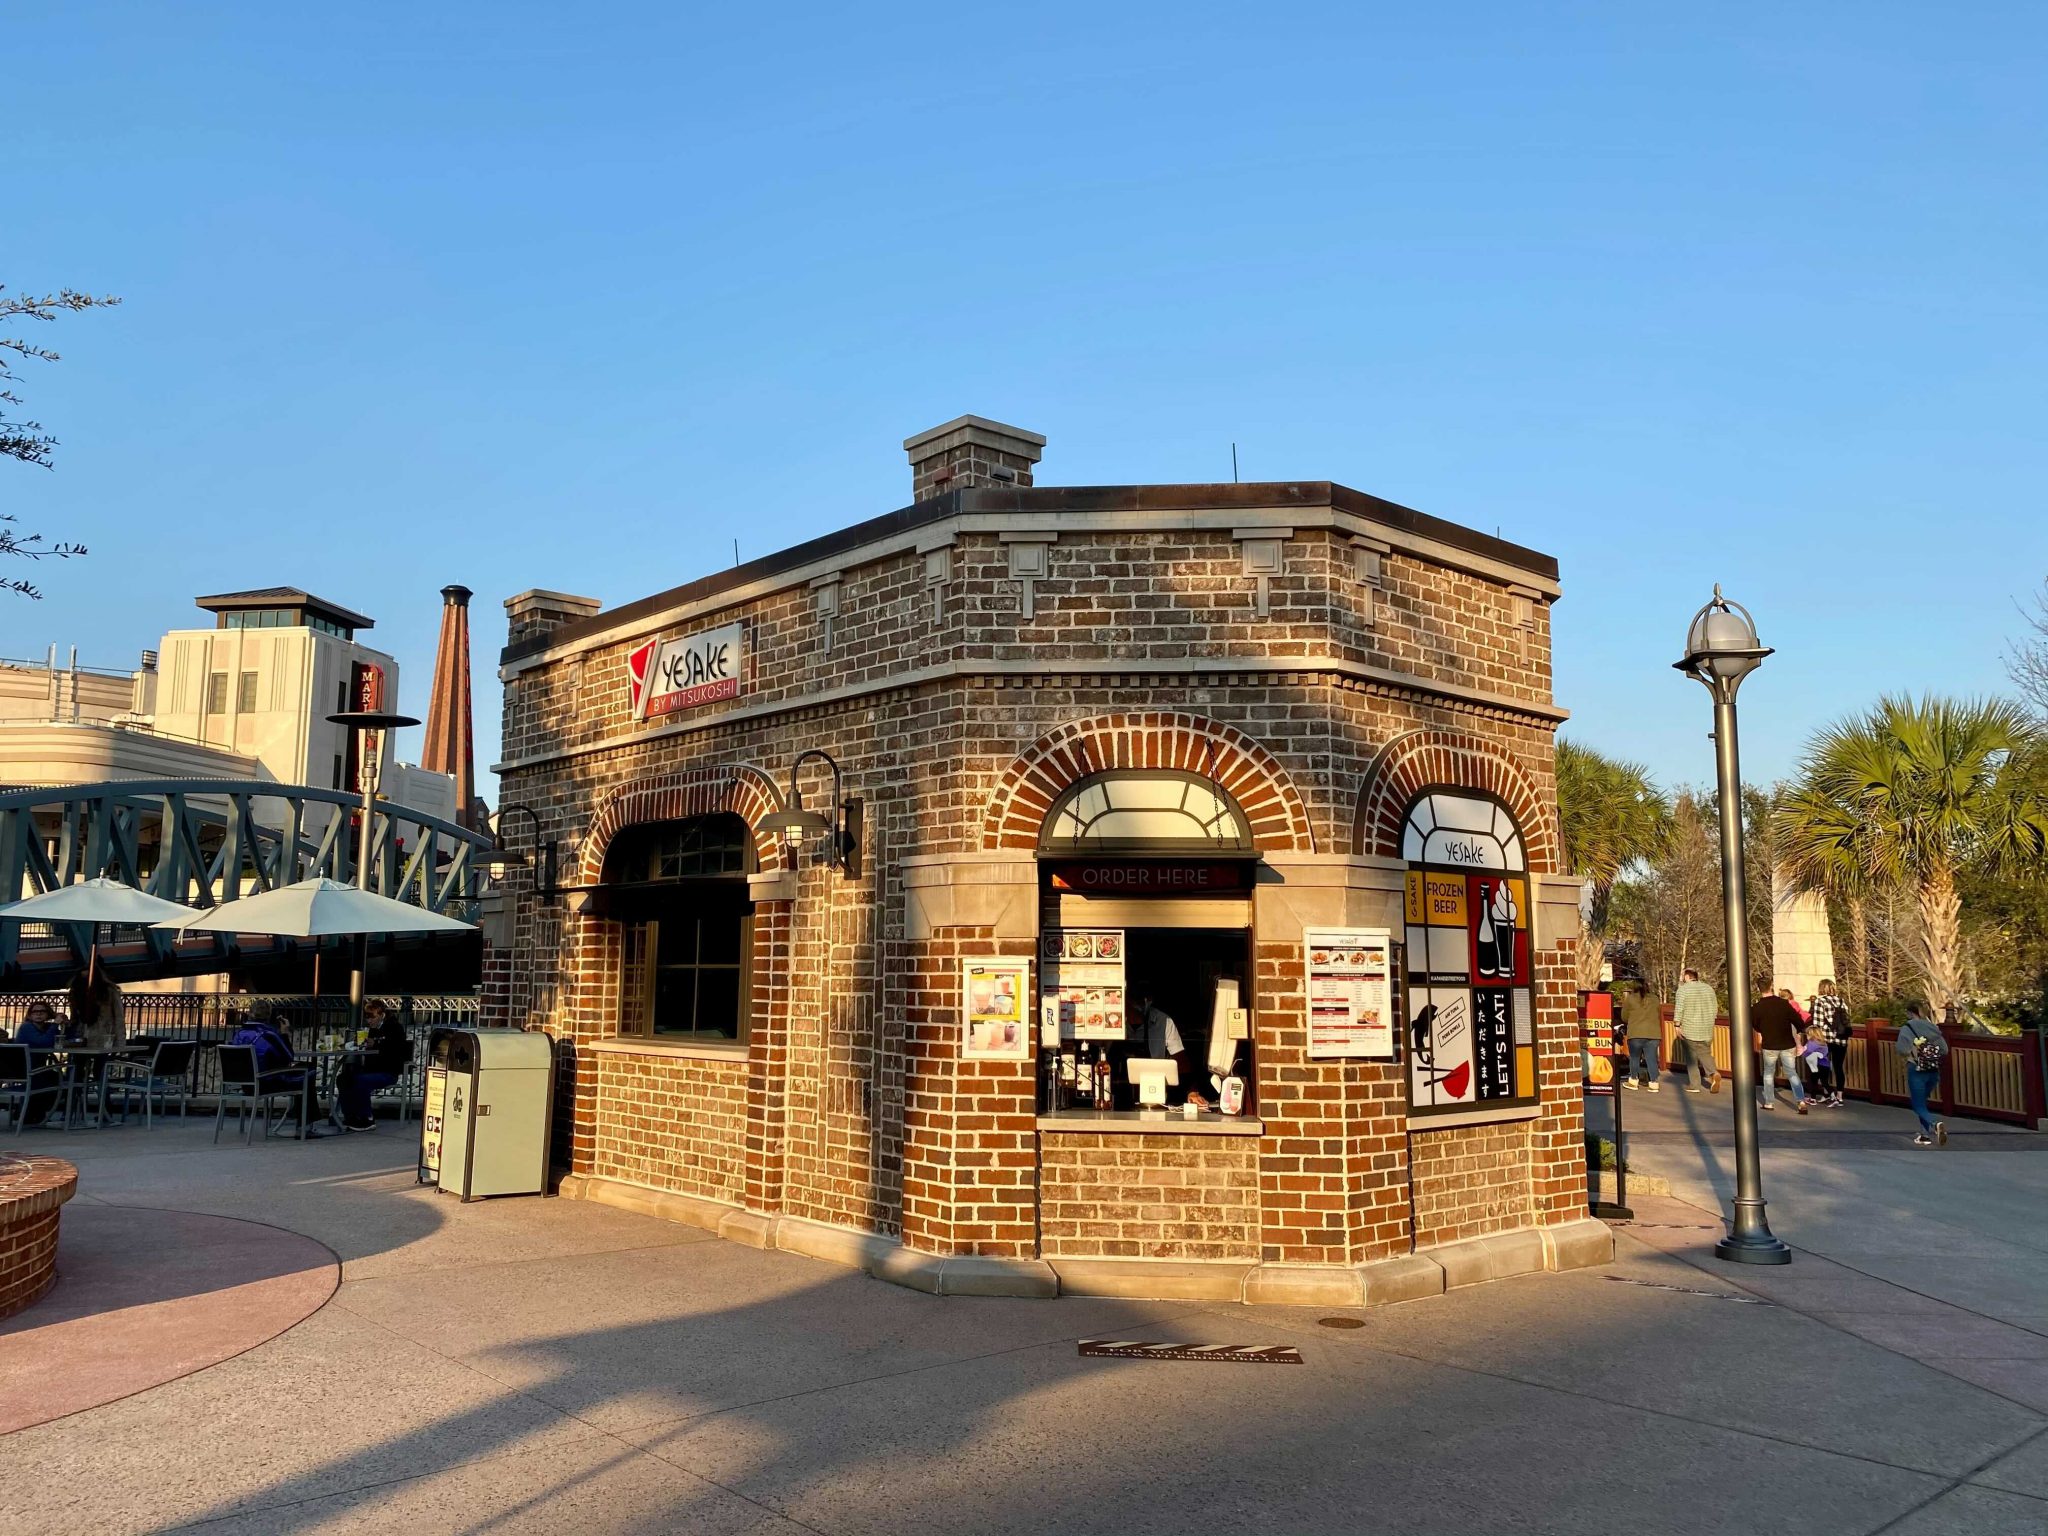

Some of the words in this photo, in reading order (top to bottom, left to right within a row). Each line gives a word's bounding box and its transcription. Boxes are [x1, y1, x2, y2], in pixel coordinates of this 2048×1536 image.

[662, 642, 728, 691] YESAKE
[653, 697, 666, 712] BY
[670, 681, 734, 707] MITSUKOSHI
[1445, 837, 1484, 864] YESAKE
[1082, 868, 1150, 885] ORDER
[1158, 868, 1208, 885] HERE
[1426, 881, 1464, 898] FROZEN
[1434, 899, 1458, 914] BEER
[1493, 993, 1506, 1036] EAT!
[1594, 1020, 1612, 1029] BUN
[1477, 993, 1490, 1098] いただきます
[1595, 1039, 1613, 1047] BUN
[1496, 1041, 1509, 1096] LET'S
